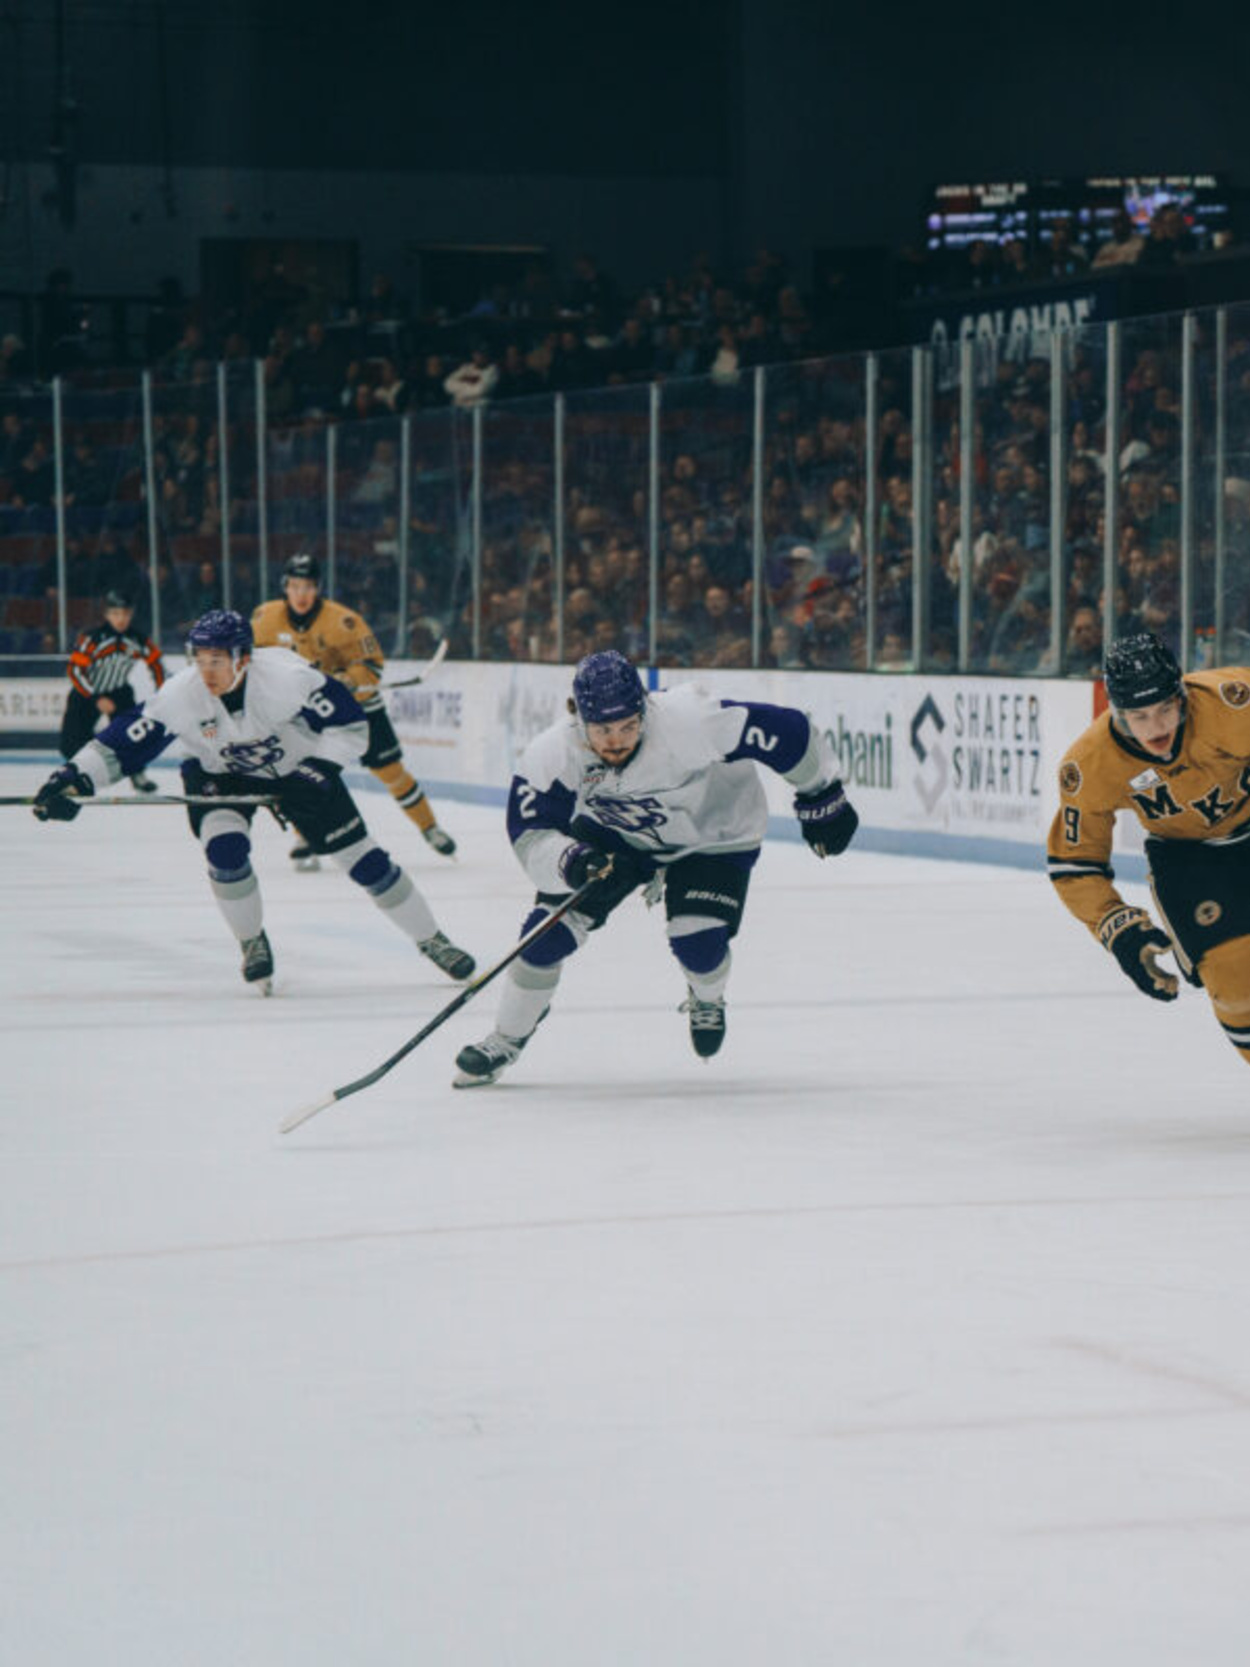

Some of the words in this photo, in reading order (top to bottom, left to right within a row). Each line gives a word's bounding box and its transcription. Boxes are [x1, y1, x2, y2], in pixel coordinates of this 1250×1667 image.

[955, 693, 1041, 743] SHAFER
[745, 726, 779, 751] 2
[953, 744, 1041, 796] SWARTZ
[516, 785, 538, 819] 2
[1063, 806, 1080, 844] 9
